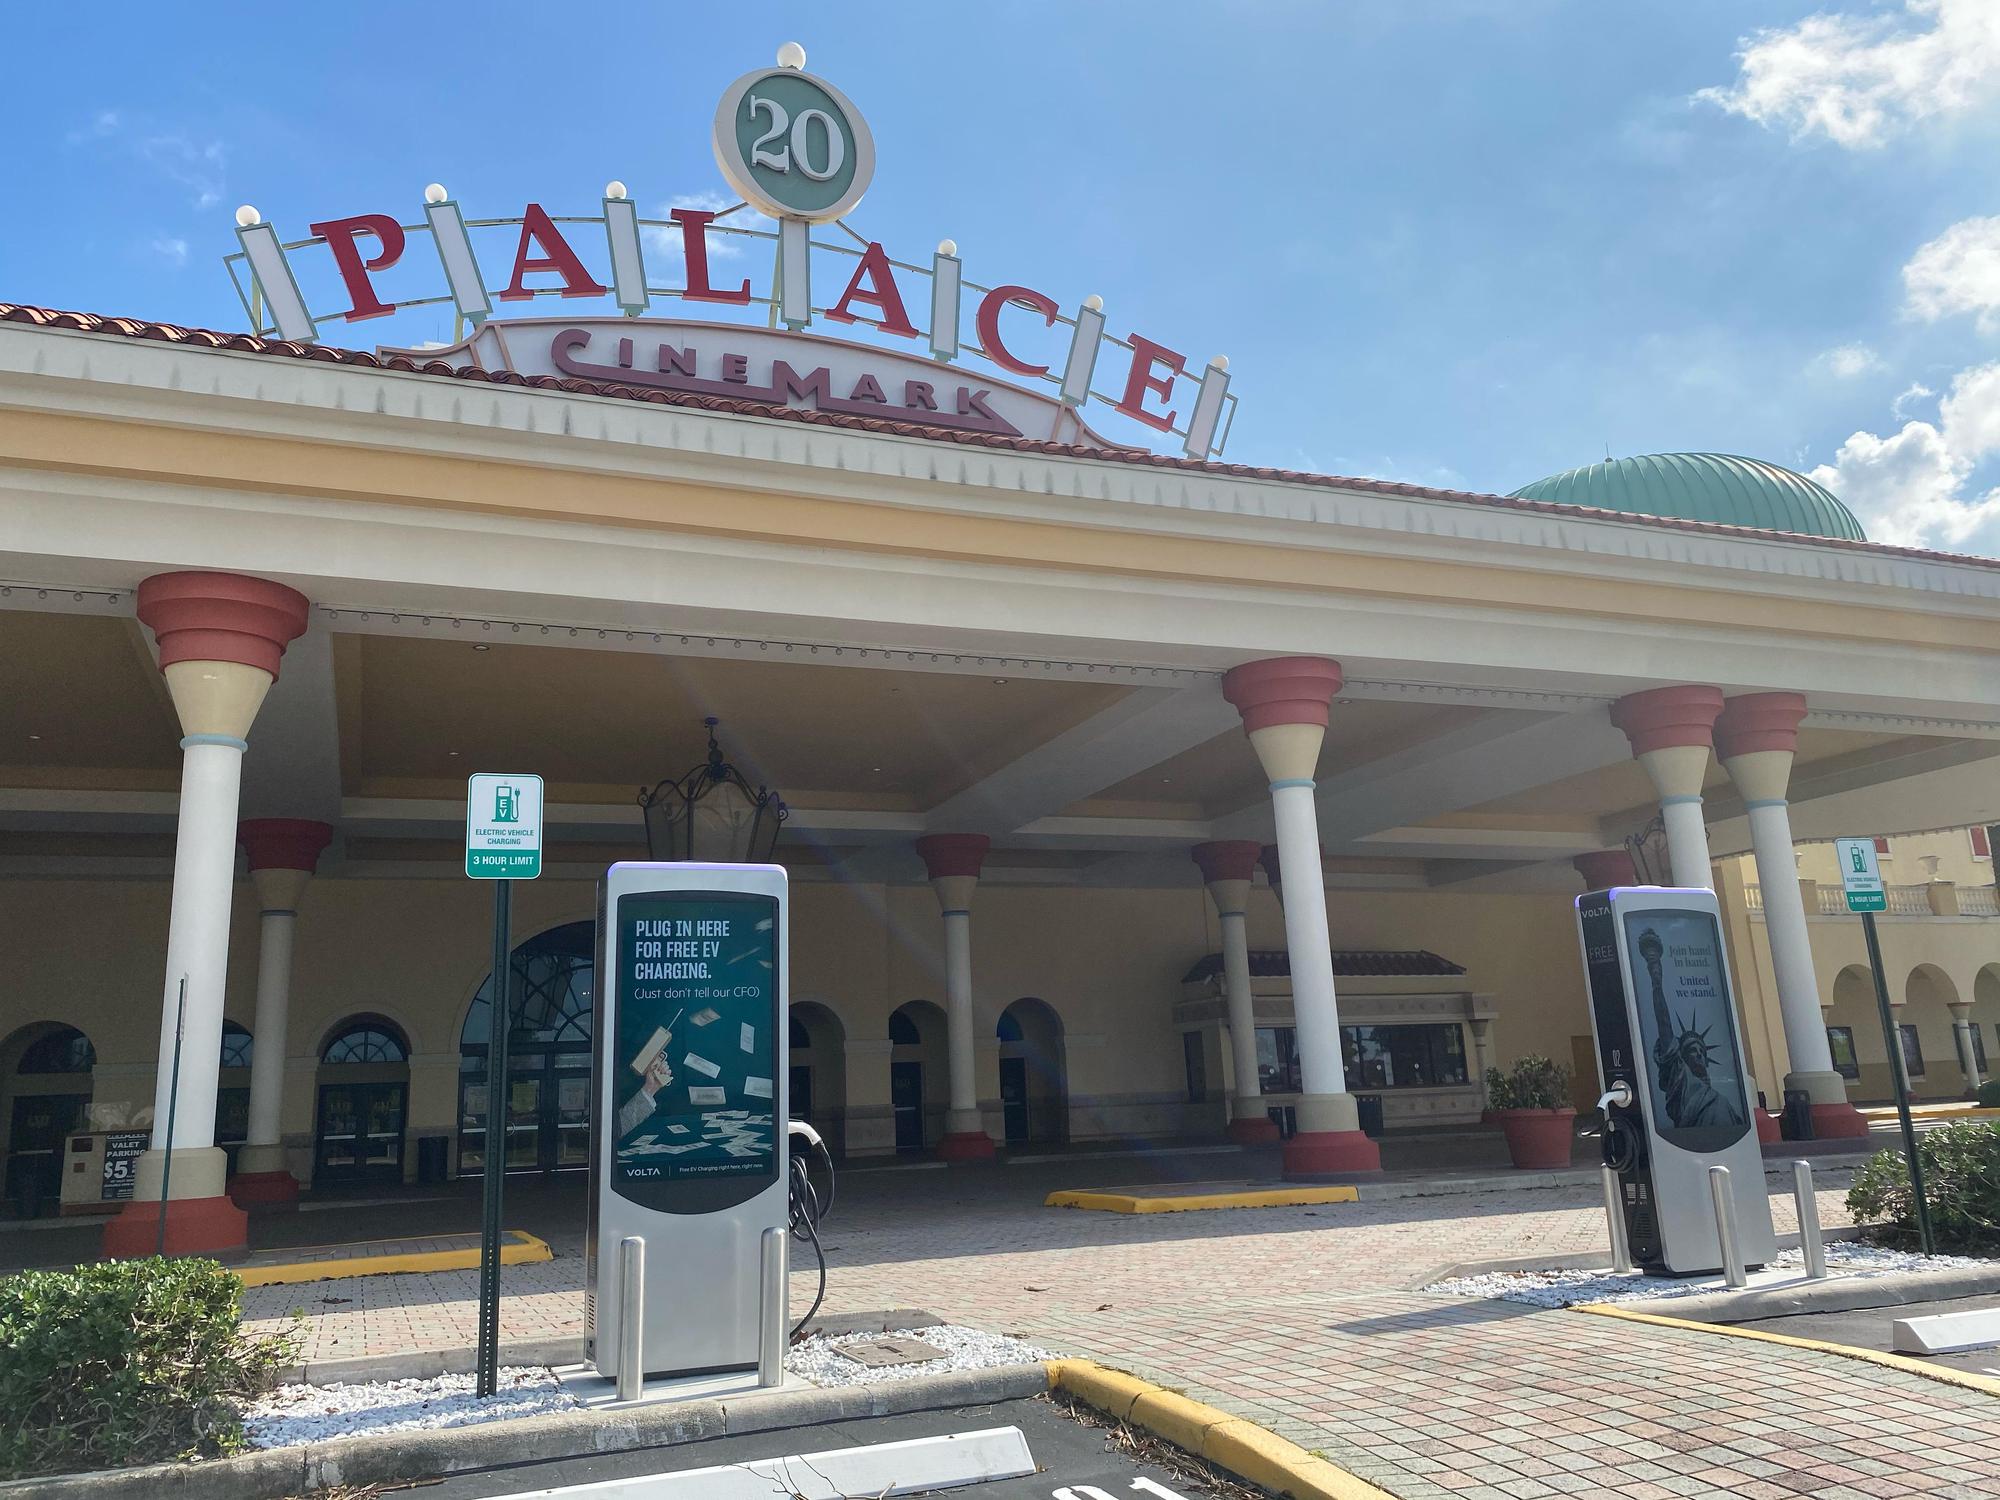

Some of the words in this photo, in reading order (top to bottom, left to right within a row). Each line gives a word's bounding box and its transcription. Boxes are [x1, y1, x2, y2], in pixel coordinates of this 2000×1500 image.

[747, 93, 846, 183] 20
[310, 203, 1186, 434] PALACE
[550, 328, 996, 421] CINEMARK
[499, 799, 508, 818] EV
[507, 829, 535, 837] VEHICLE
[473, 855, 480, 865] 3
[482, 856, 507, 865] HOUR
[509, 856, 534, 865] LIMIT
[1582, 906, 1612, 919] VOLTA
[636, 920, 671, 937] PLUG
[675, 920, 692, 937] IN
[696, 920, 730, 937] HERE
[635, 941, 662, 958] FOR
[666, 941, 698, 958] FREE
[702, 941, 720, 958] EV
[1669, 944, 1688, 957] Join
[1689, 944, 1712, 956] hand
[1674, 957, 1683, 967] in
[1685, 957, 1711, 967] hand.
[635, 962, 712, 980] CHARGING.
[1679, 975, 1710, 986] United
[634, 988, 661, 1000] (Just
[664, 987, 691, 999] don't
[694, 986, 710, 998] tell
[712, 988, 731, 998] our
[733, 986, 760, 998] CFO)
[1675, 989, 1689, 998] we
[1690, 987, 1717, 998] stand.
[112, 1141, 140, 1149] VALET
[104, 1160, 128, 1179] $5
[626, 1167, 661, 1177] VOLTA
